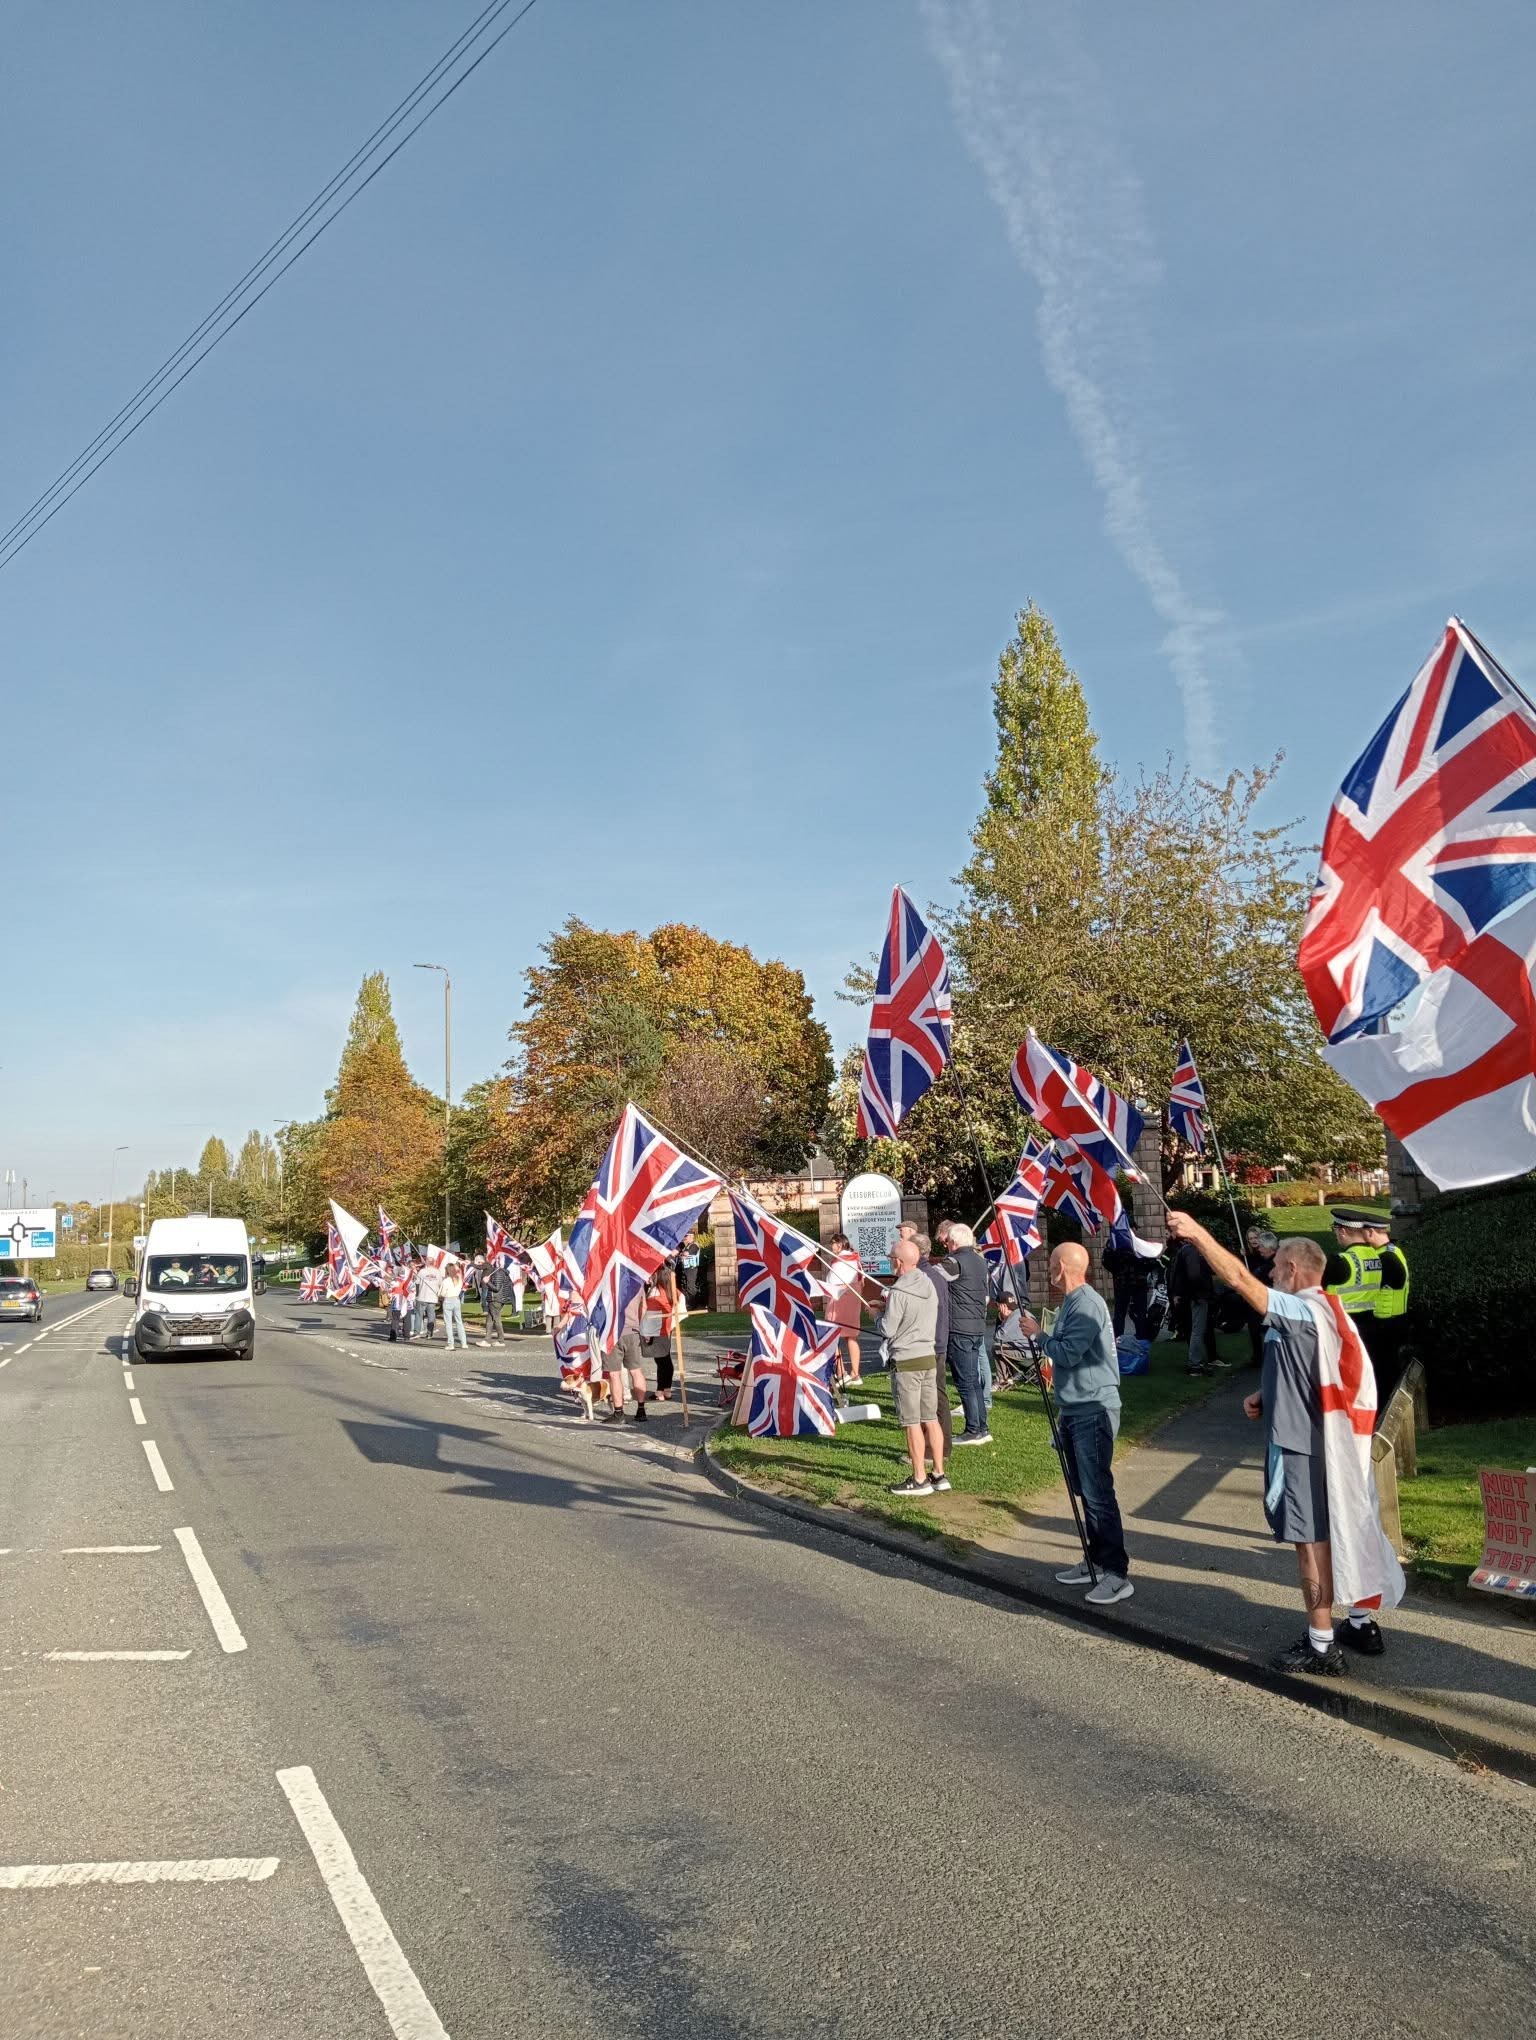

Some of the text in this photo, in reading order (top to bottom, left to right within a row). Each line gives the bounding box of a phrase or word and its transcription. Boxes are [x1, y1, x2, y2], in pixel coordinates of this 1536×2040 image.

[1364, 1259, 1383, 1270] POLIC
[1481, 1471, 1527, 1499] NOT
[1485, 1495, 1529, 1522] NOT
[1487, 1520, 1532, 1548] NOT
[1485, 1547, 1536, 1574] JUST
